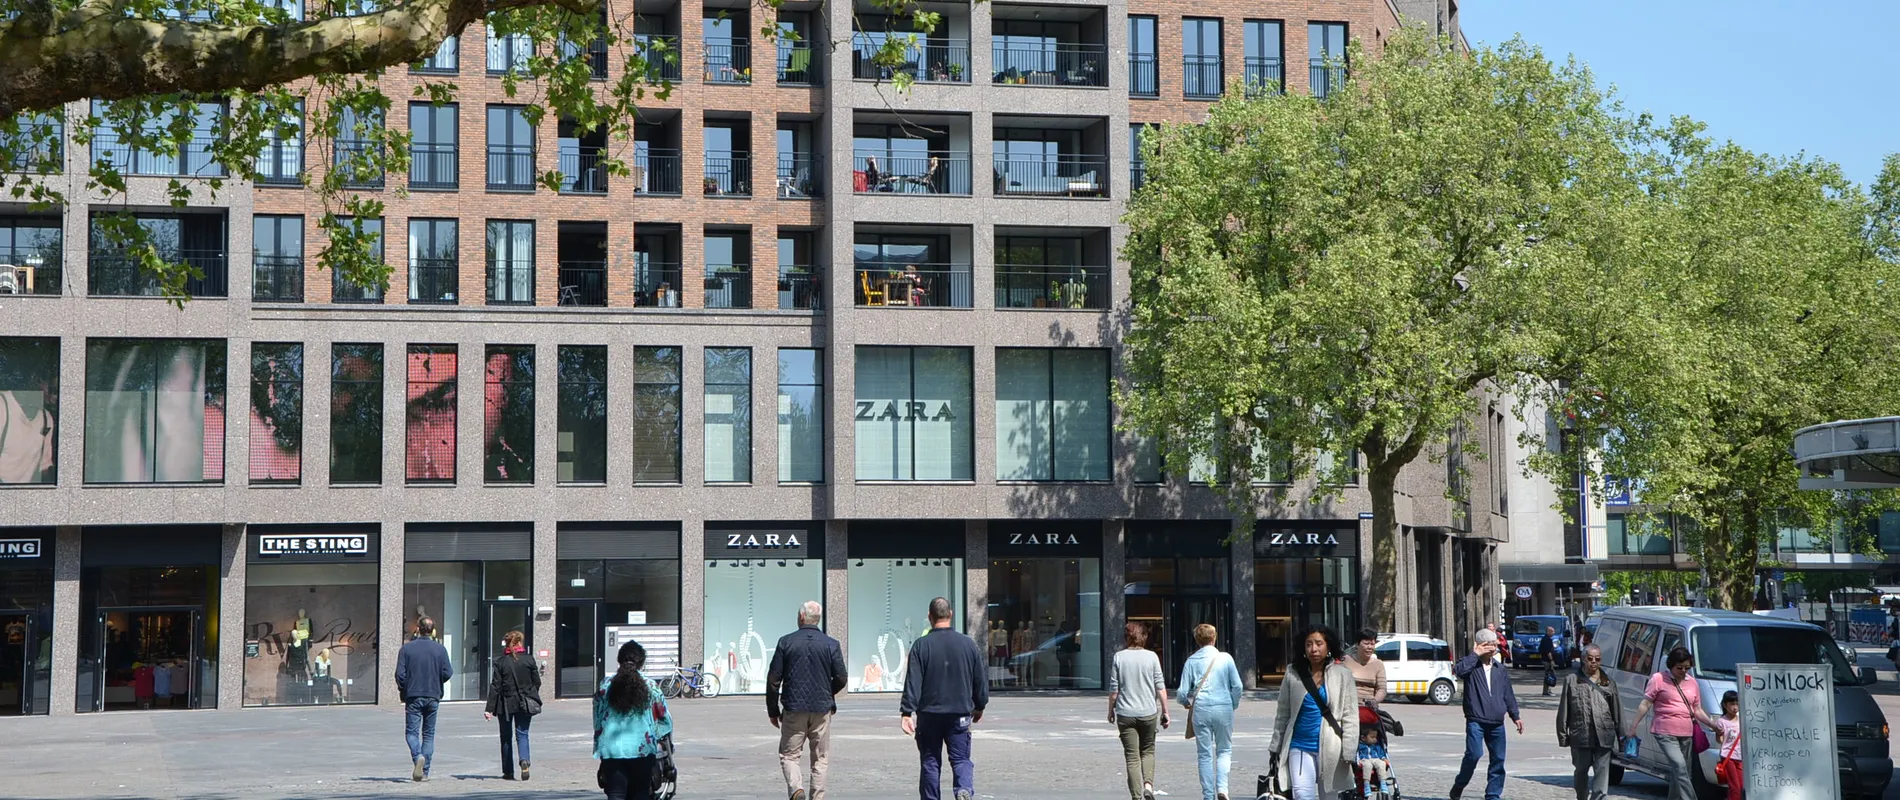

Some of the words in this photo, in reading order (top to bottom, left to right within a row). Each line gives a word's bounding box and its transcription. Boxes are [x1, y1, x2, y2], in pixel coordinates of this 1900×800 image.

[855, 401, 957, 422] ZARA
[265, 539, 300, 550] THE
[305, 538, 363, 550] STING
[727, 533, 802, 547] ZARA
[1009, 533, 1080, 545] ZARA
[1270, 533, 1340, 545] ZARA
